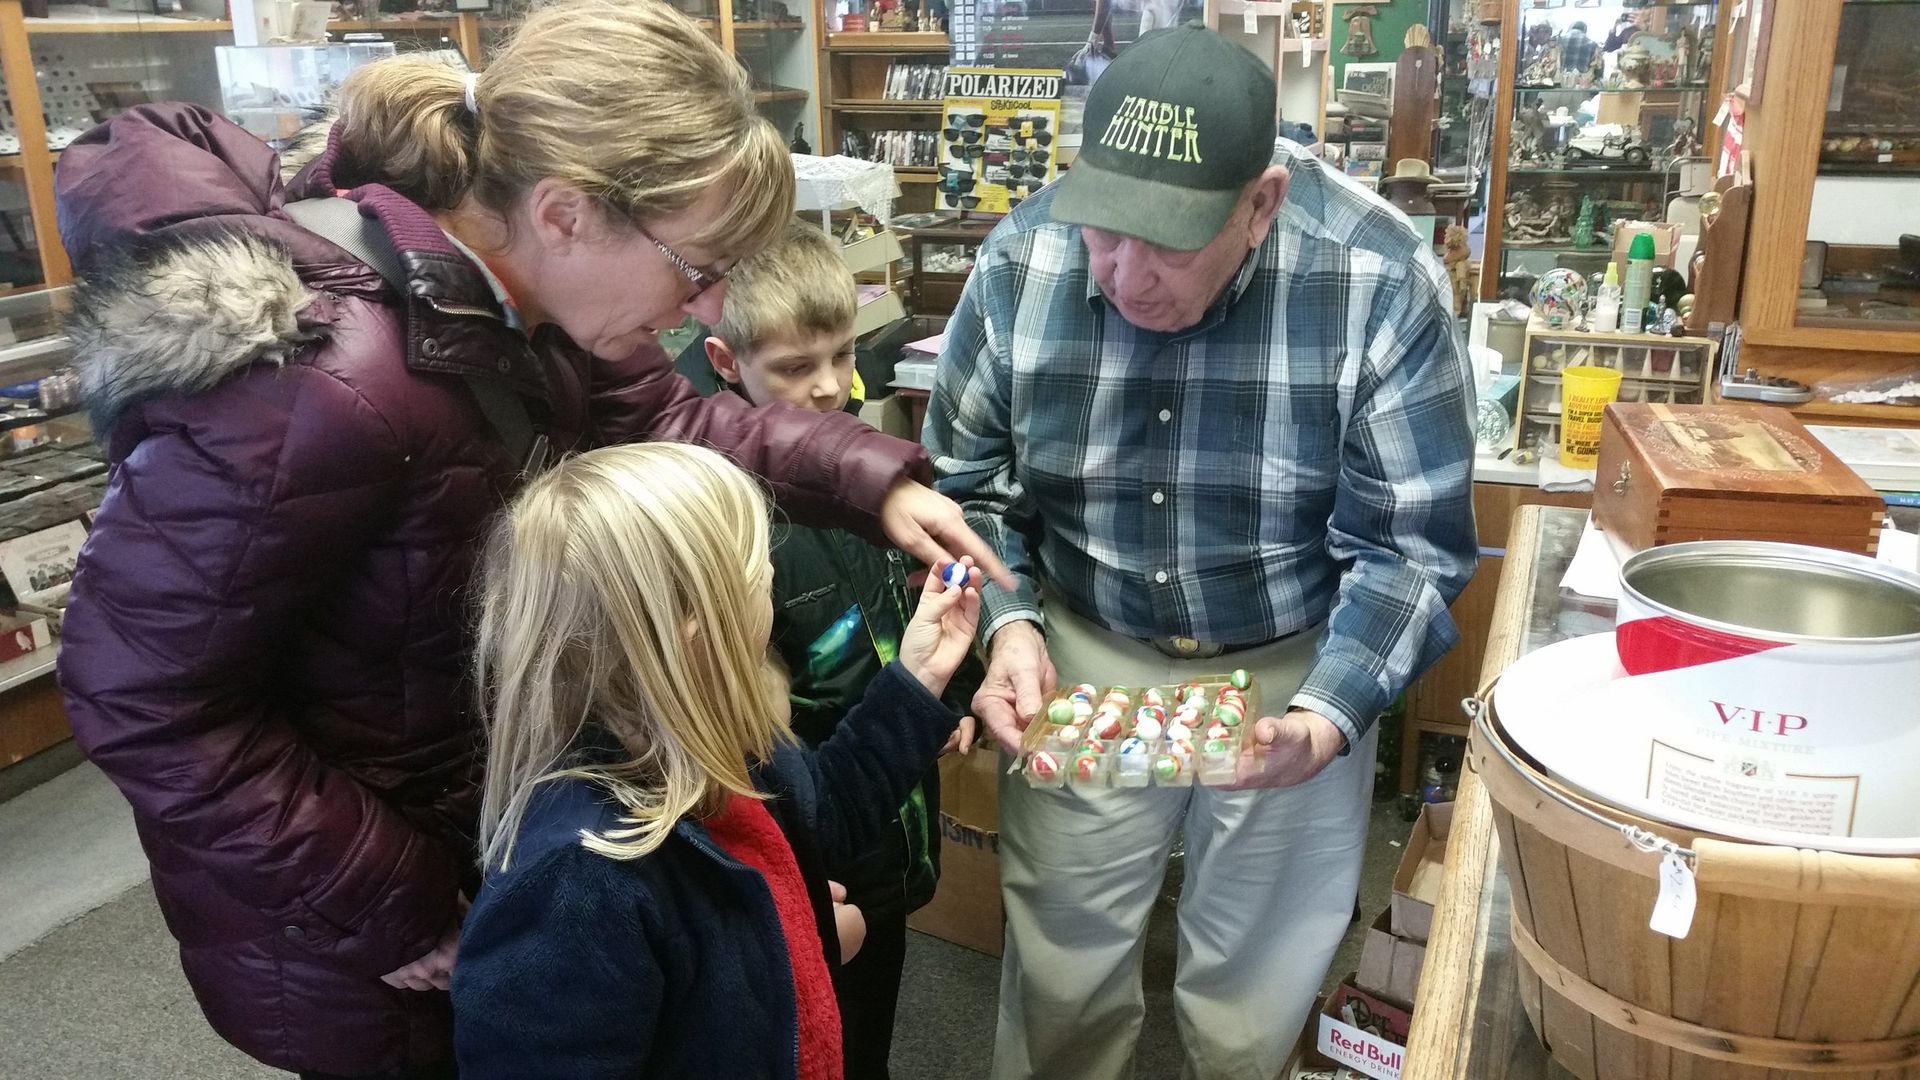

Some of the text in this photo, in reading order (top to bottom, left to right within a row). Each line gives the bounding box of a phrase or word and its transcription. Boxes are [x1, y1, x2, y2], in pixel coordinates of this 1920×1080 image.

[947, 74, 1059, 98] POLARIZED
[1116, 94, 1198, 130] MARBLE
[1099, 114, 1203, 164] HUNTER
[1738, 736, 1817, 755] MIXTURE
[1329, 1045, 1400, 1079] ENERGY DRINK
[1330, 1028, 1401, 1070] Red Bull
